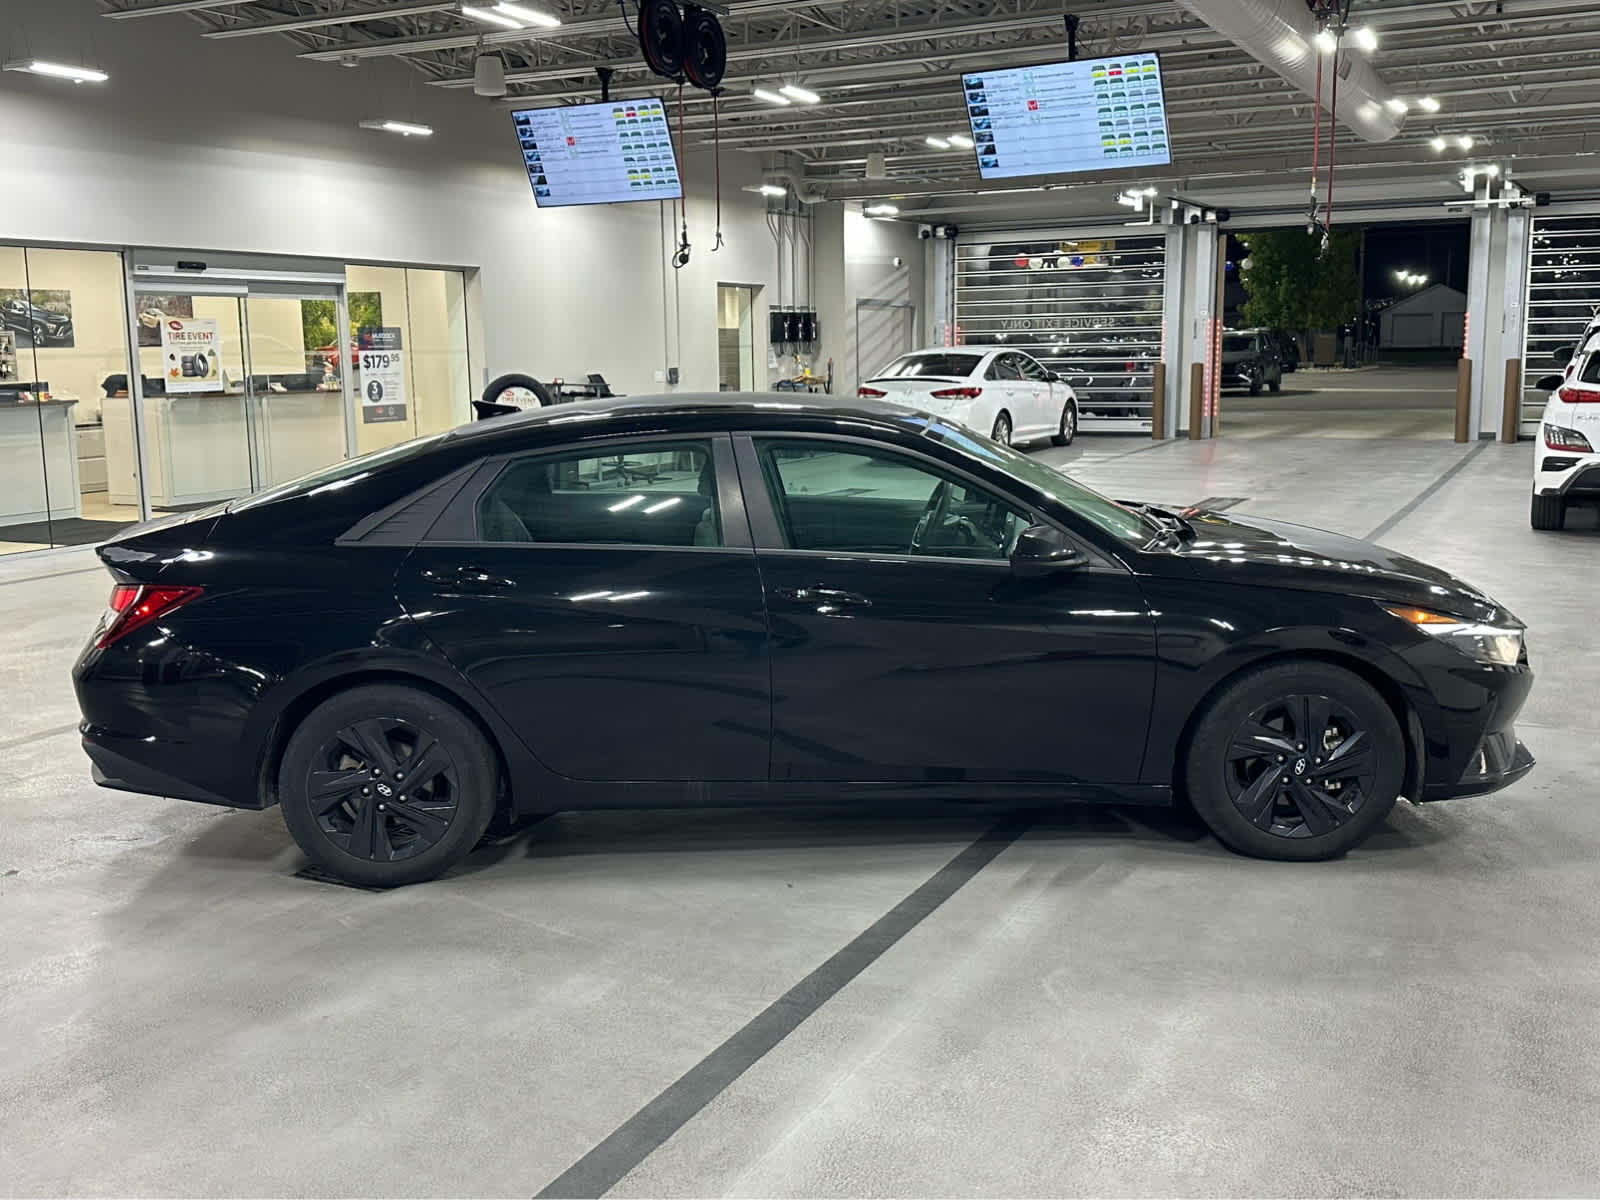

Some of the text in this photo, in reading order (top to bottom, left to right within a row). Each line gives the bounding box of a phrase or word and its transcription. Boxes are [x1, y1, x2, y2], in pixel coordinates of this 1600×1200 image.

[168, 332, 213, 340] TIRE EVENT
[363, 354, 390, 370] $179
[371, 382, 378, 394] 3
